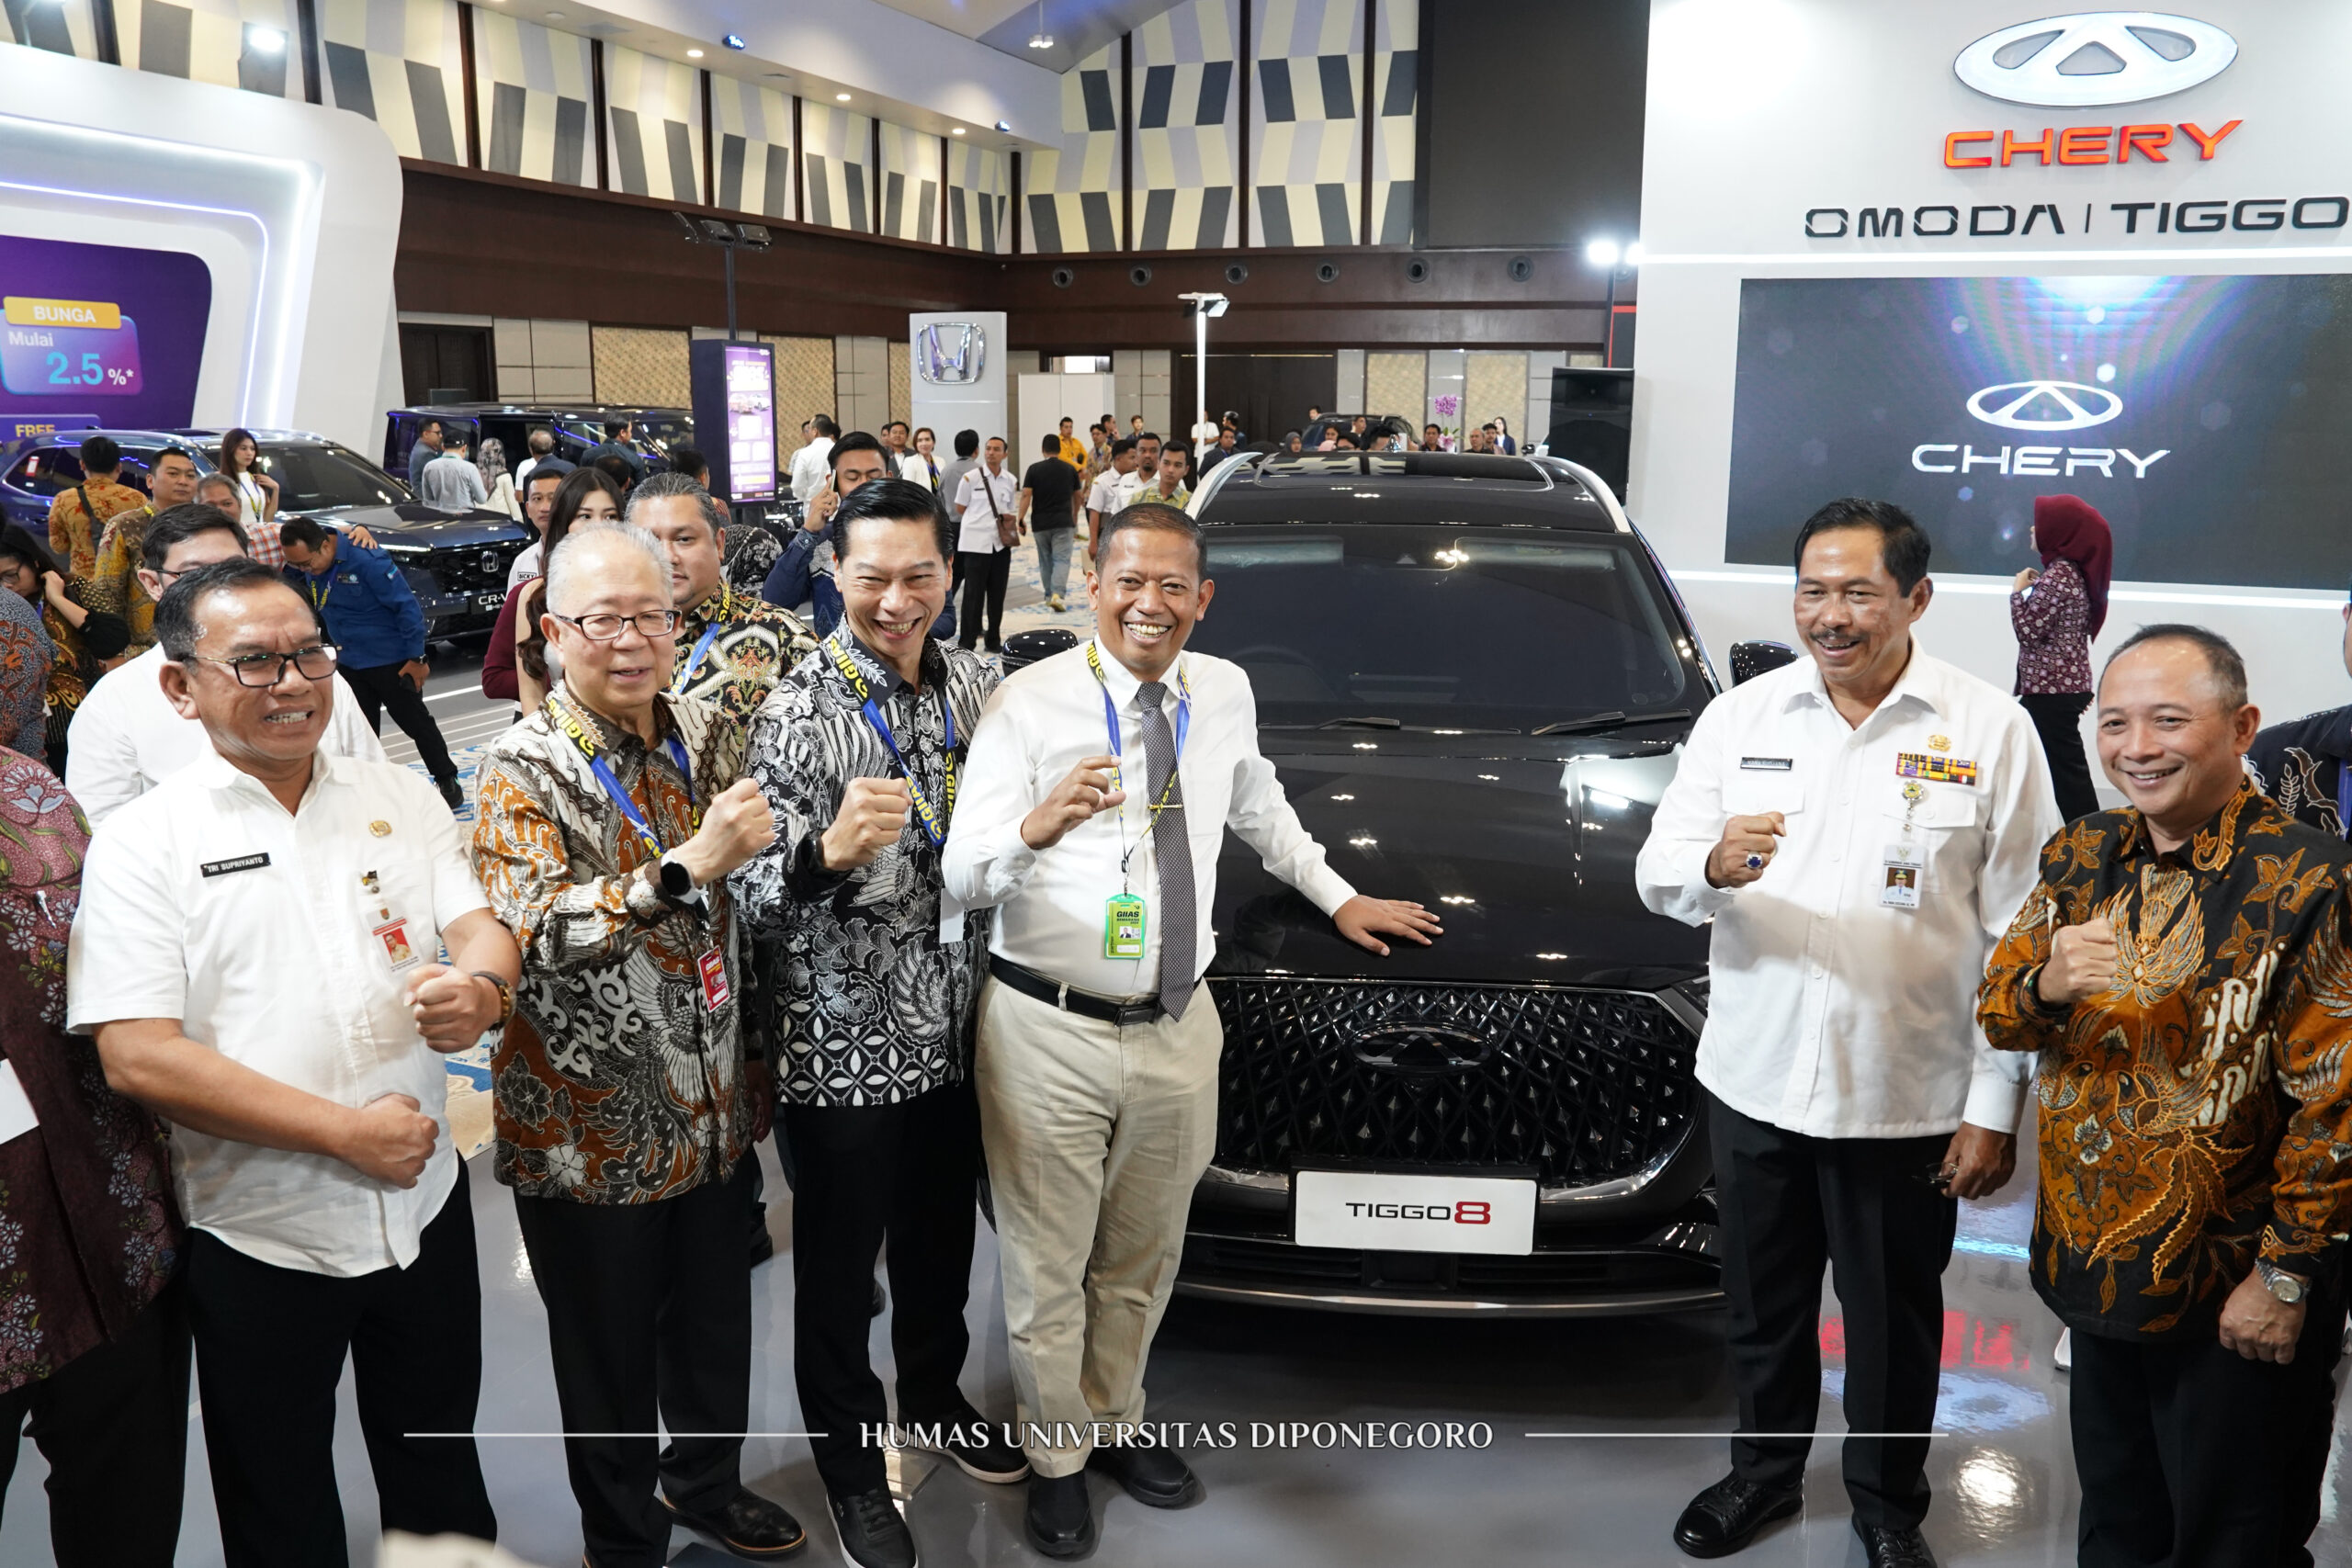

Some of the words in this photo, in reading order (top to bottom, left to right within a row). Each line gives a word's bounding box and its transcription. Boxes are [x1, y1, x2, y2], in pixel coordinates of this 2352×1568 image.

[1944, 119, 2244, 167] CHERY
[1805, 204, 2065, 237] OMODA
[2110, 197, 2350, 233] TIGGO
[33, 306, 96, 322] BUNGA
[8, 331, 54, 346] Mulai
[1912, 445, 2171, 478] CHERY
[208, 864, 220, 873] TRI
[220, 856, 264, 870] SUPRIYANTO
